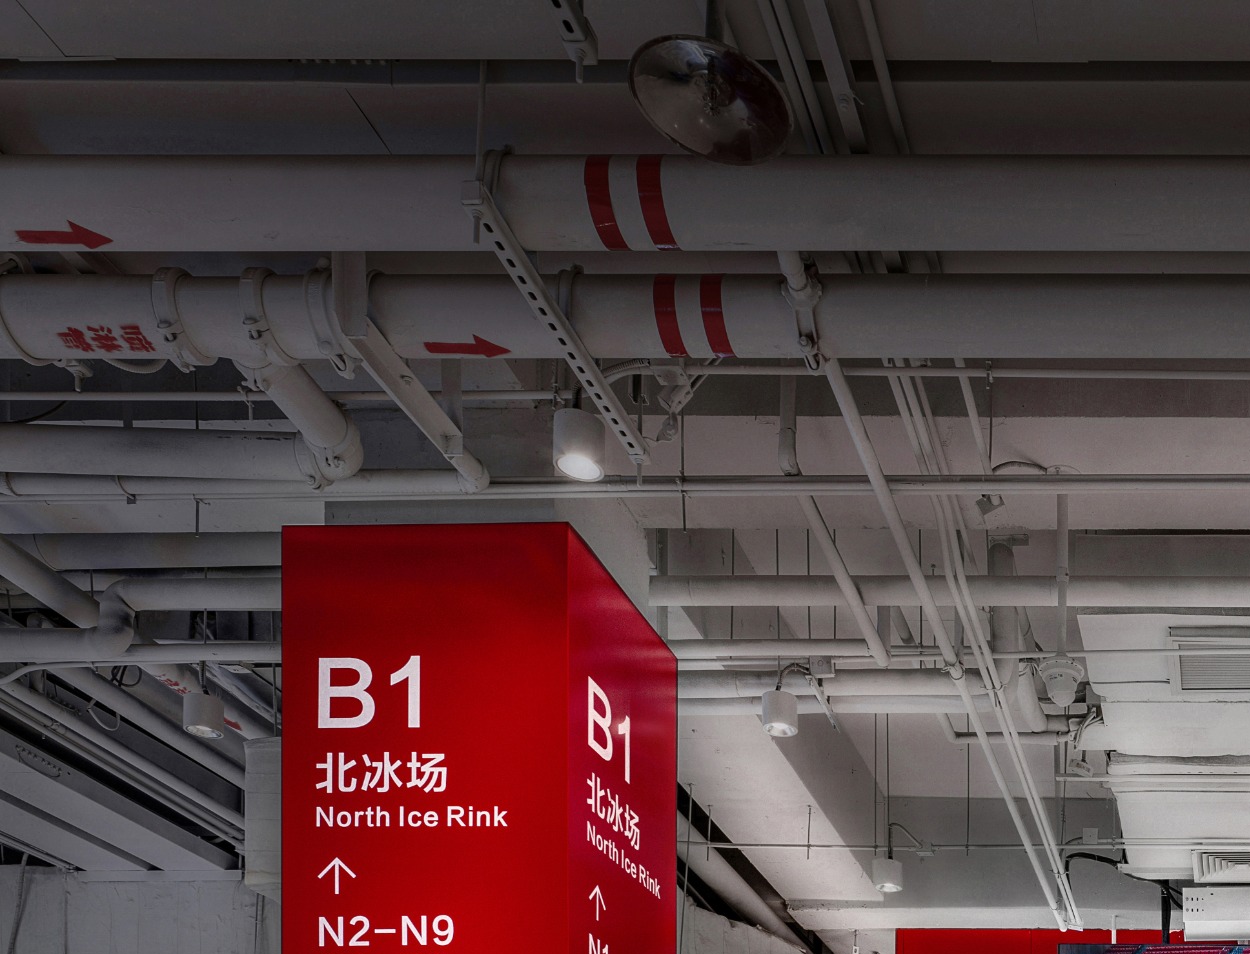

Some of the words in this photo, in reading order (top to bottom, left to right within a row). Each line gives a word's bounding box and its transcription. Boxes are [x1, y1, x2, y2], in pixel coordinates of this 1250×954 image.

[317, 655, 421, 729] B1
[587, 676, 631, 785] B1
[315, 751, 448, 794] 北冰场
[315, 805, 390, 828] North
[399, 806, 439, 828] Ice
[446, 806, 508, 828] Rink
[586, 772, 640, 851] 北冰场
[586, 820, 619, 865] North
[621, 848, 637, 879] Ice
[638, 863, 661, 900] Rink
[318, 914, 455, 947] N2-N9
